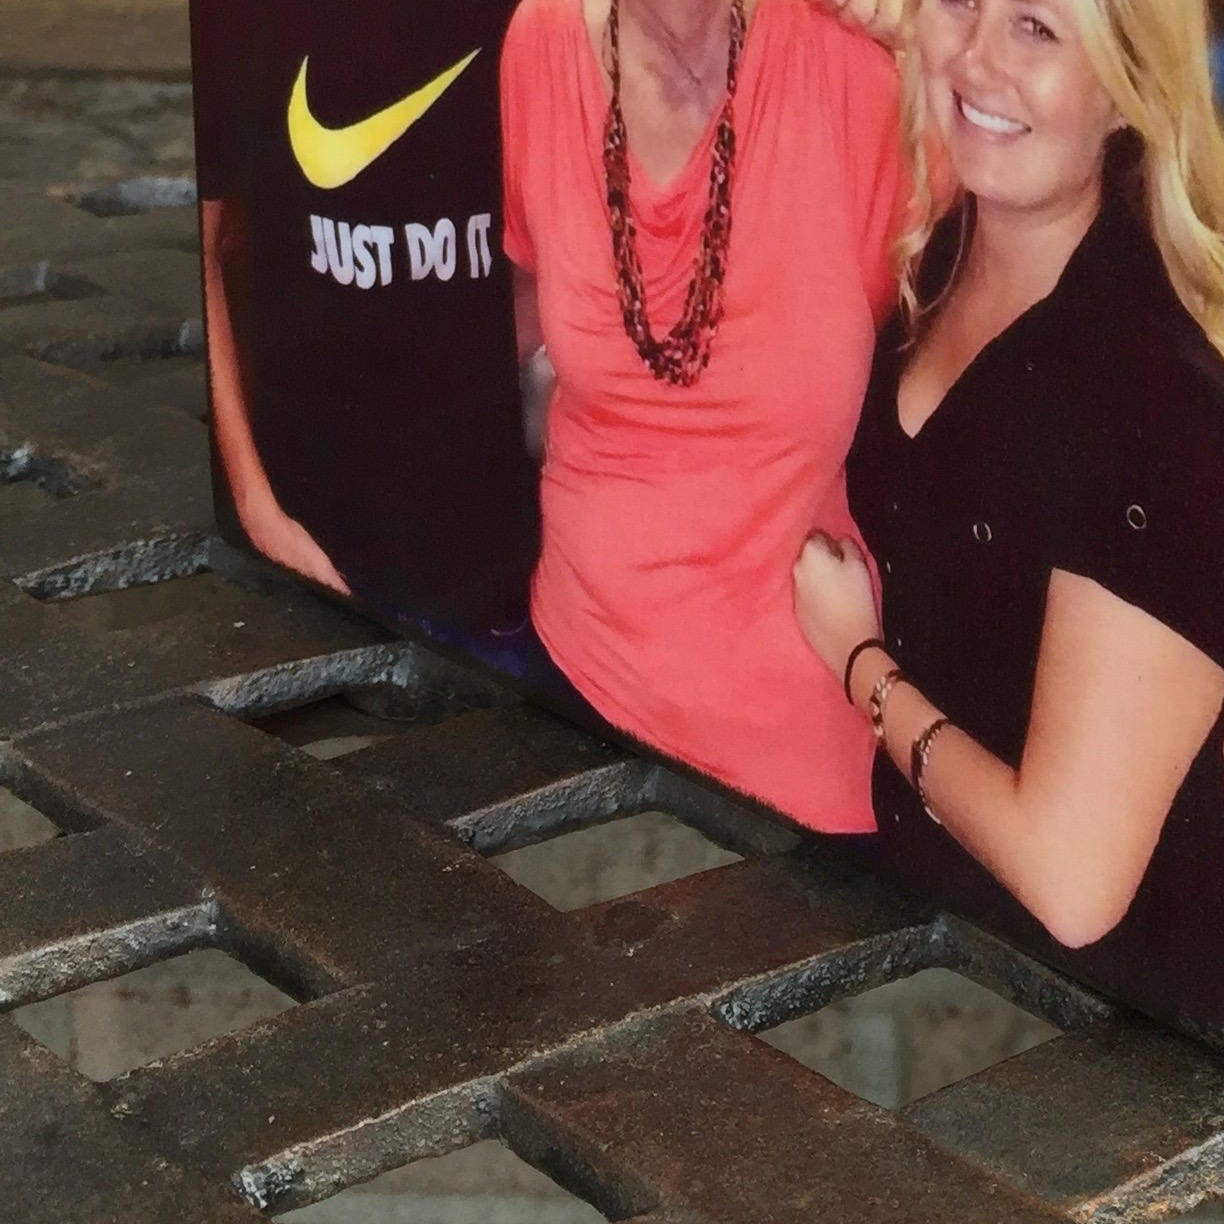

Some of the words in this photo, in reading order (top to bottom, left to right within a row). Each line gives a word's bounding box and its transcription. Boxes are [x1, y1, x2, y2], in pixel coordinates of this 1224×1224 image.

[309, 213, 395, 290] JUST
[404, 217, 457, 282] DO
[466, 212, 493, 280] IT
